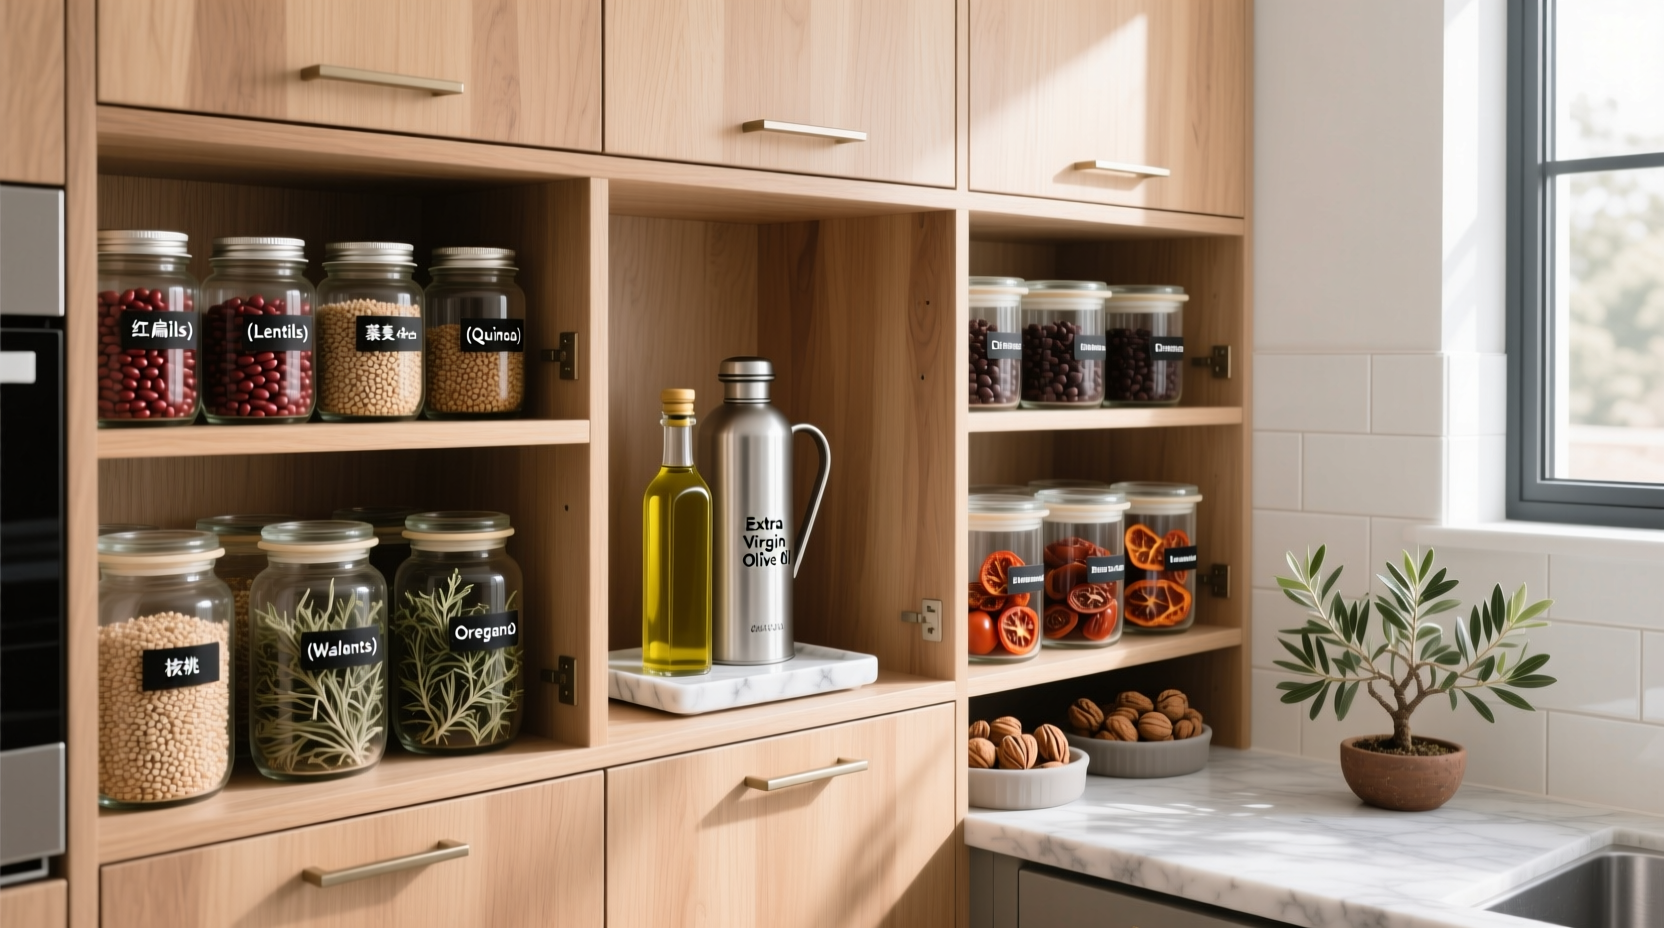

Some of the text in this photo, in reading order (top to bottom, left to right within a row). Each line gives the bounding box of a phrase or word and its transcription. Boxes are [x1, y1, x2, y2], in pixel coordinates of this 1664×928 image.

[247, 322, 309, 343] (Lentils)
[466, 326, 521, 346] (Quinoa)
[745, 516, 783, 531] Extra
[742, 533, 786, 552] Virgin
[742, 551, 777, 568] Olive
[454, 622, 517, 643] Oregano
